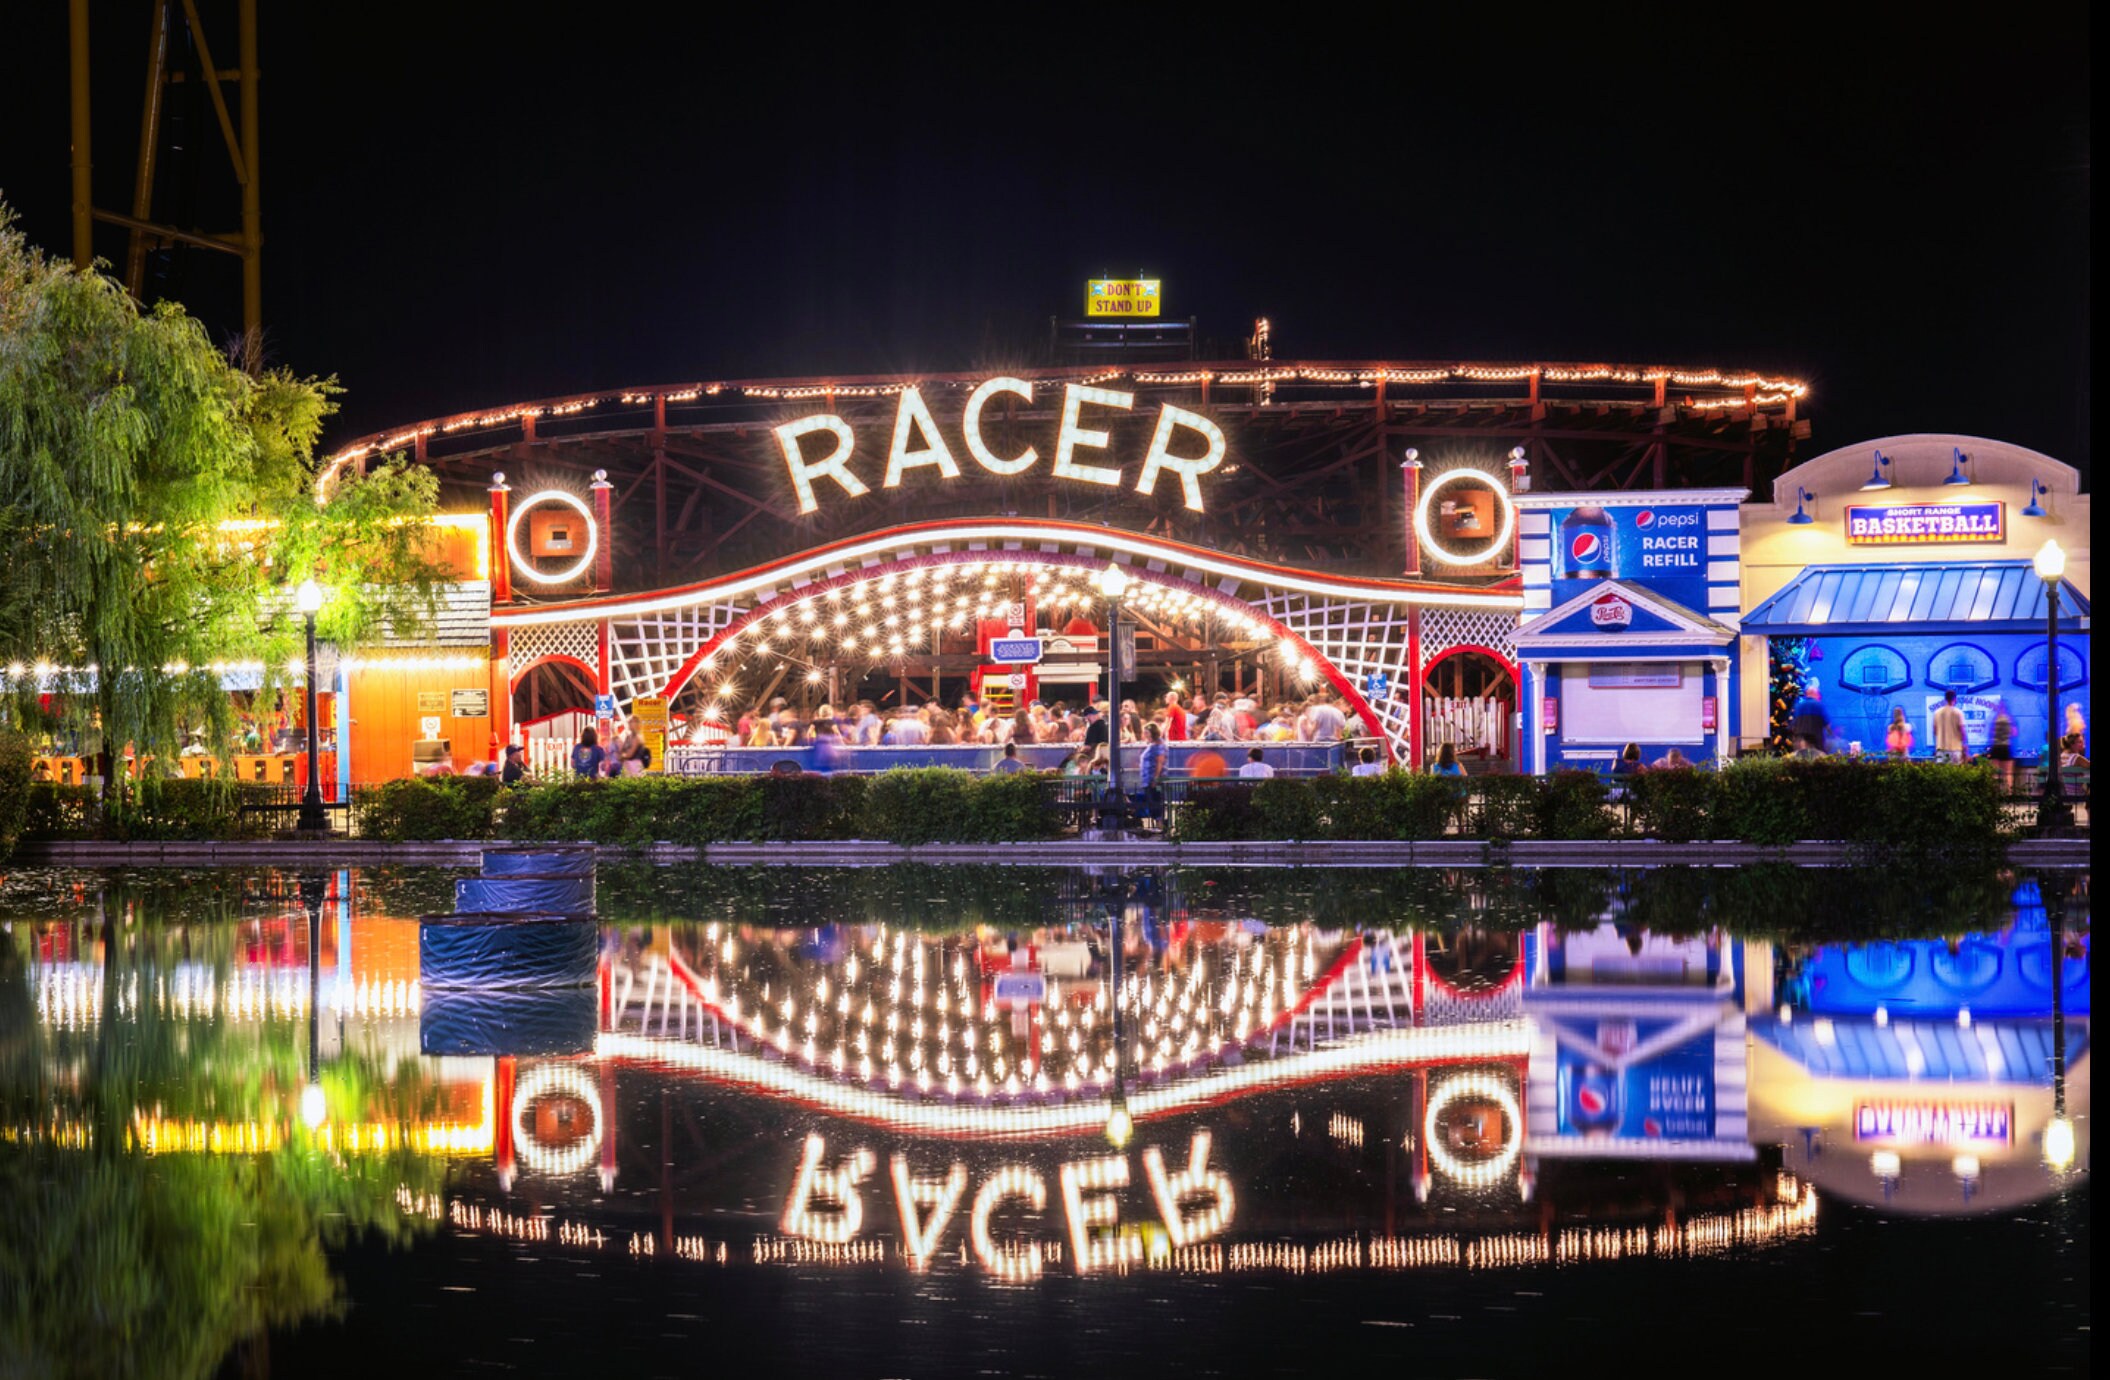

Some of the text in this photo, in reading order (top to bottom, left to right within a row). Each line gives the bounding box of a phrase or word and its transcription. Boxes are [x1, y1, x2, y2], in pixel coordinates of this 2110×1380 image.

[1107, 283, 1142, 296] DON'T
[1095, 300, 1152, 312] STAND UP
[772, 376, 1227, 515] RACER
[1887, 507, 1962, 516] SHORT RANGE
[1657, 512, 1699, 528] pepsi
[1852, 515, 1998, 535] BASKETBALL
[1603, 535, 1611, 562] pepsi
[1643, 536, 1699, 549] RACER
[1643, 554, 1699, 567] REFILL
